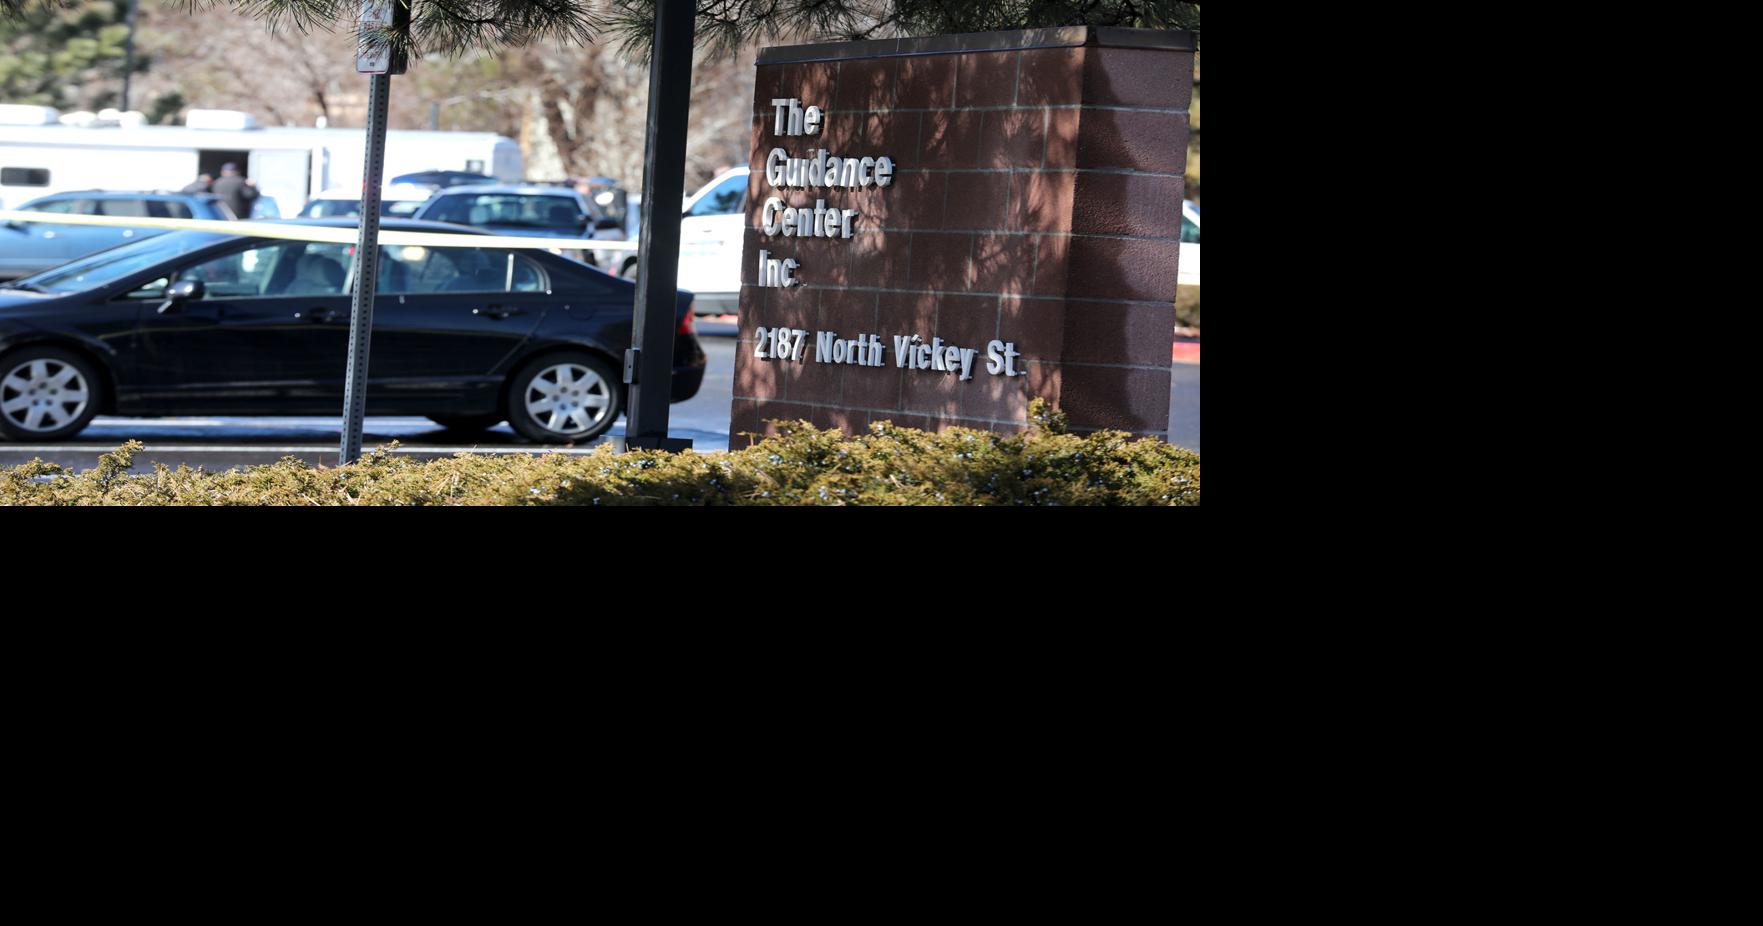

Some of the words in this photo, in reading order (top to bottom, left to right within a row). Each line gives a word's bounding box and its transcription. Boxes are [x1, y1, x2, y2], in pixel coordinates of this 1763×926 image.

[772, 98, 821, 136] The
[766, 148, 893, 187] Guidance
[762, 197, 855, 238] Center
[754, 327, 805, 361] 2187
[816, 330, 883, 367] North
[893, 334, 976, 381] Vickey
